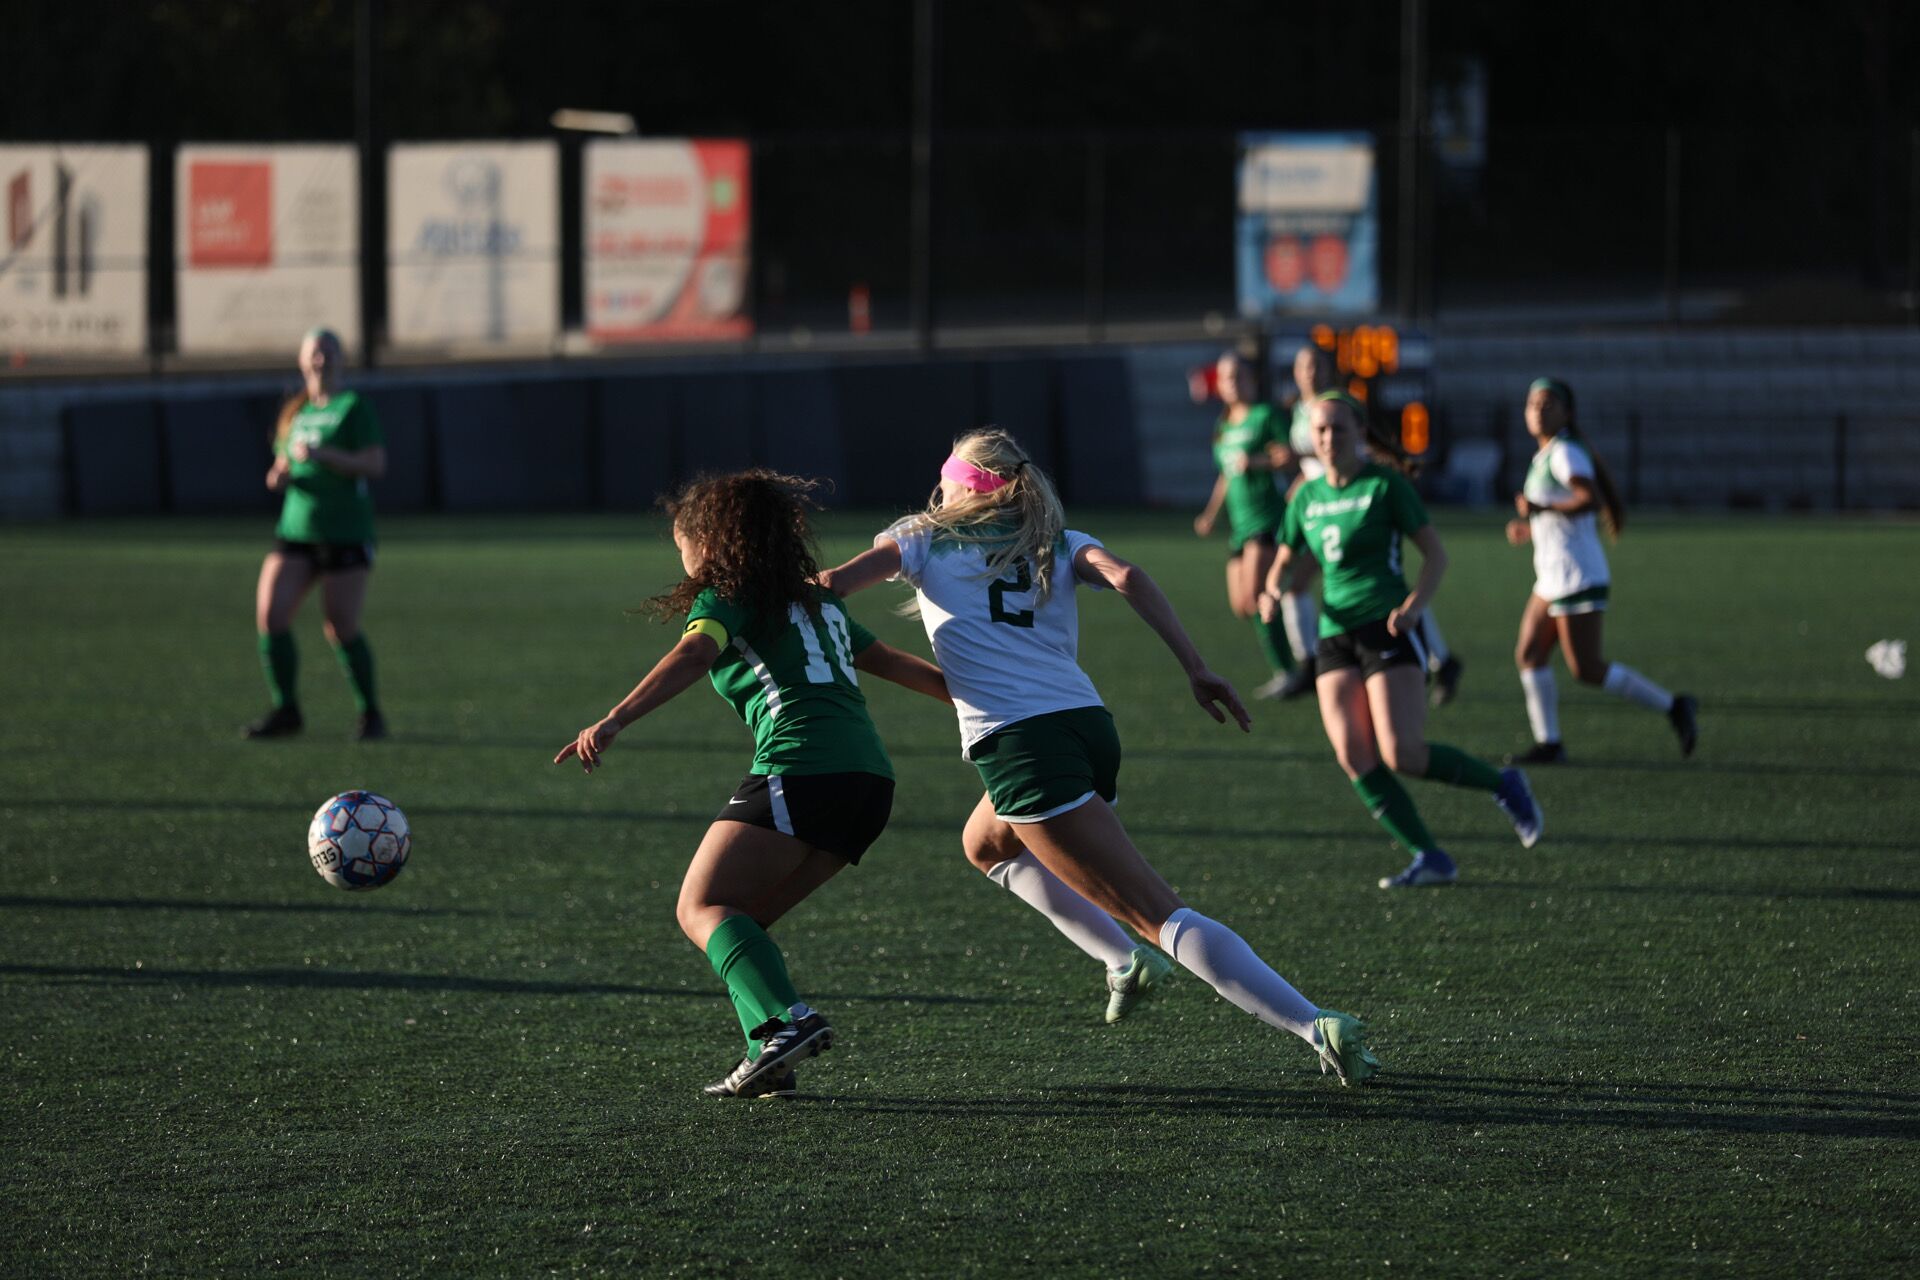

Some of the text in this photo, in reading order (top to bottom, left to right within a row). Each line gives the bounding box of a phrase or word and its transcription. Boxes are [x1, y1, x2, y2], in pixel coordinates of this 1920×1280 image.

[1321, 525, 1343, 563] 2
[986, 550, 1035, 628] 2
[788, 601, 858, 687] 10
